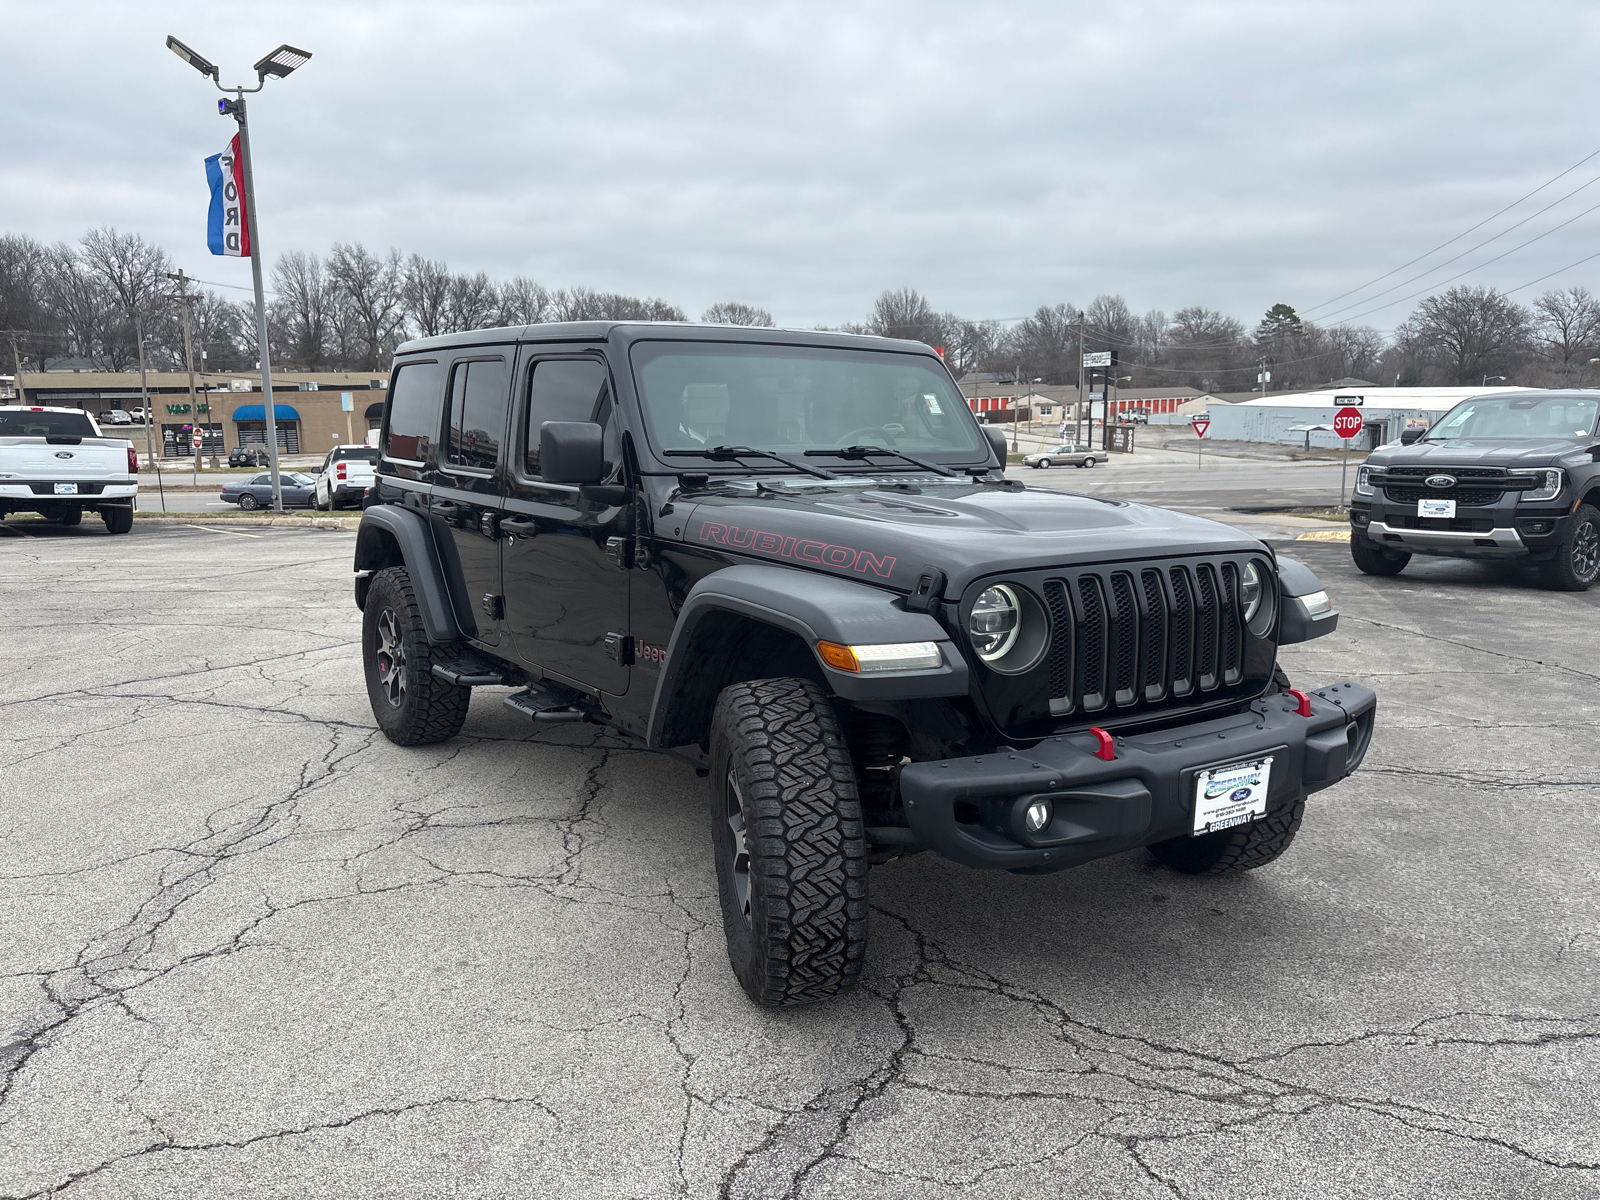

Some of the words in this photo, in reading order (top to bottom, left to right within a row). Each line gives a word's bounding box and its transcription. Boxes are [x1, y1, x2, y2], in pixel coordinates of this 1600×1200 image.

[1334, 416, 1361, 430] STOP
[700, 521, 896, 578] RUBICON
[1206, 772, 1261, 794] GREENWAY
[1233, 789, 1248, 801] Ford
[1210, 813, 1253, 832] GREENWAY
